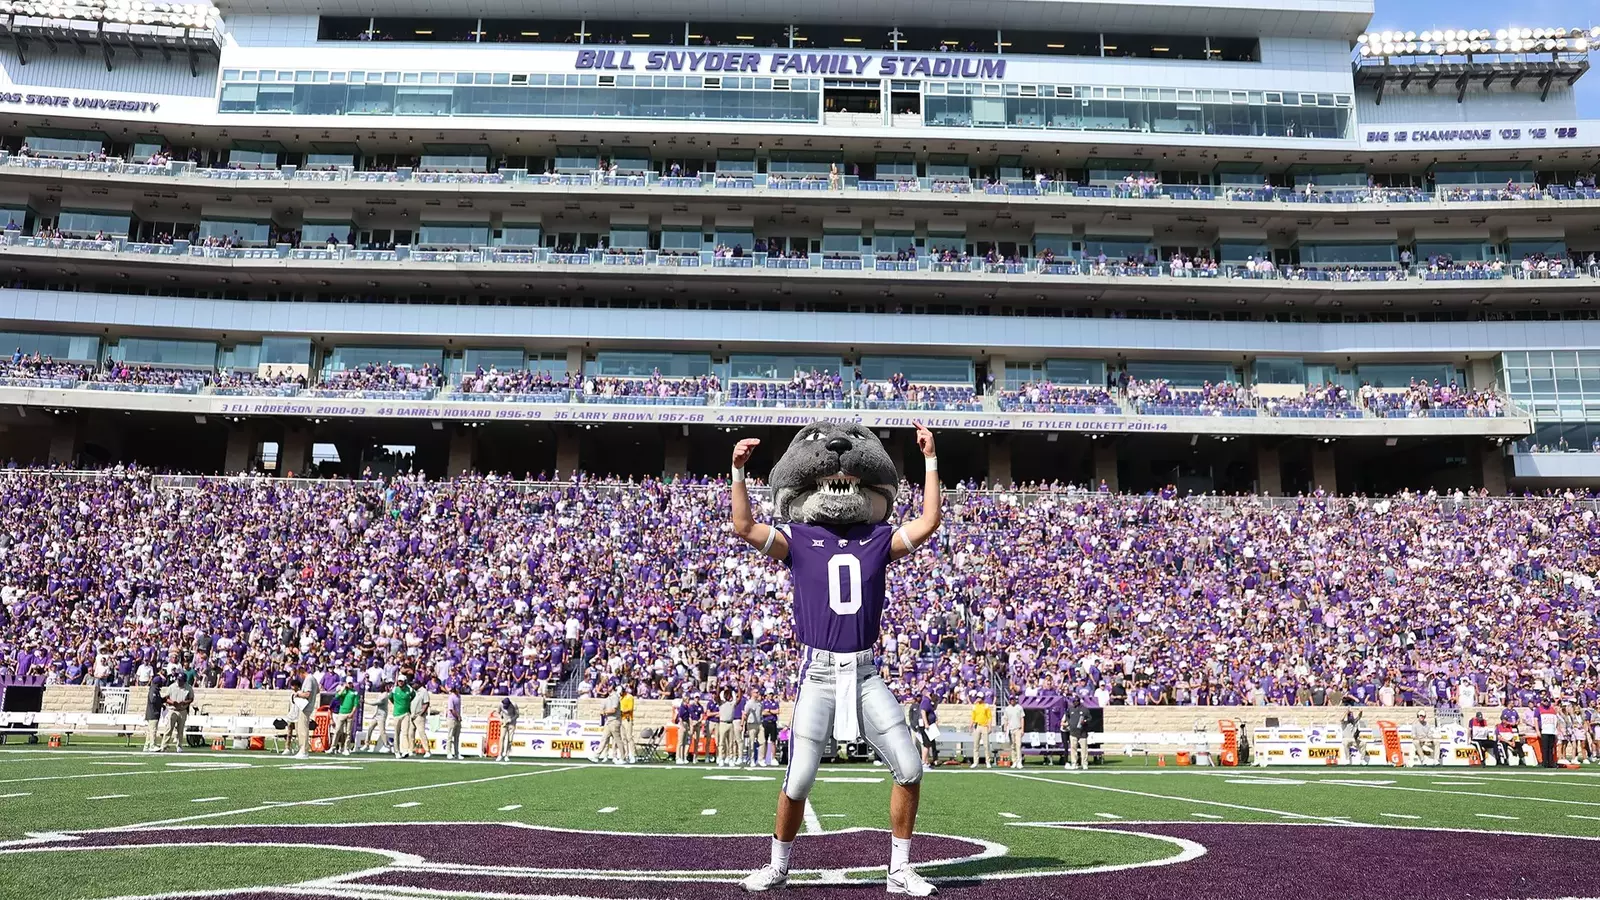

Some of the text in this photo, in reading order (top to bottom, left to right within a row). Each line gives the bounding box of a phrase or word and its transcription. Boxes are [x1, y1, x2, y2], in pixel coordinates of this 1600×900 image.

[575, 50, 1006, 78] BILL SNYDER FAMILY STADIUM
[25, 94, 70, 107] STATE
[73, 97, 160, 113] UNIVERSITY
[1366, 131, 1389, 142] BIG
[1394, 131, 1408, 142] 12
[1411, 130, 1491, 141] CHAMPIONS
[1498, 128, 1521, 139] '03
[221, 404, 228, 412] 3
[254, 405, 312, 414] ROBERSON
[316, 406, 366, 415] 2000-03
[377, 408, 542, 419] 49 DARREN HOWARD 1996-99
[554, 411, 704, 422] 36 LARRY BROWN 1967-68
[727, 415, 773, 423] ARTHUR
[777, 415, 819, 424] BROWN
[885, 418, 923, 426] COLLN
[928, 419, 960, 427] KLEIN
[1022, 420, 1168, 430] 16 TYLER LOCKETT 2011-14
[828, 553, 862, 615] 0
